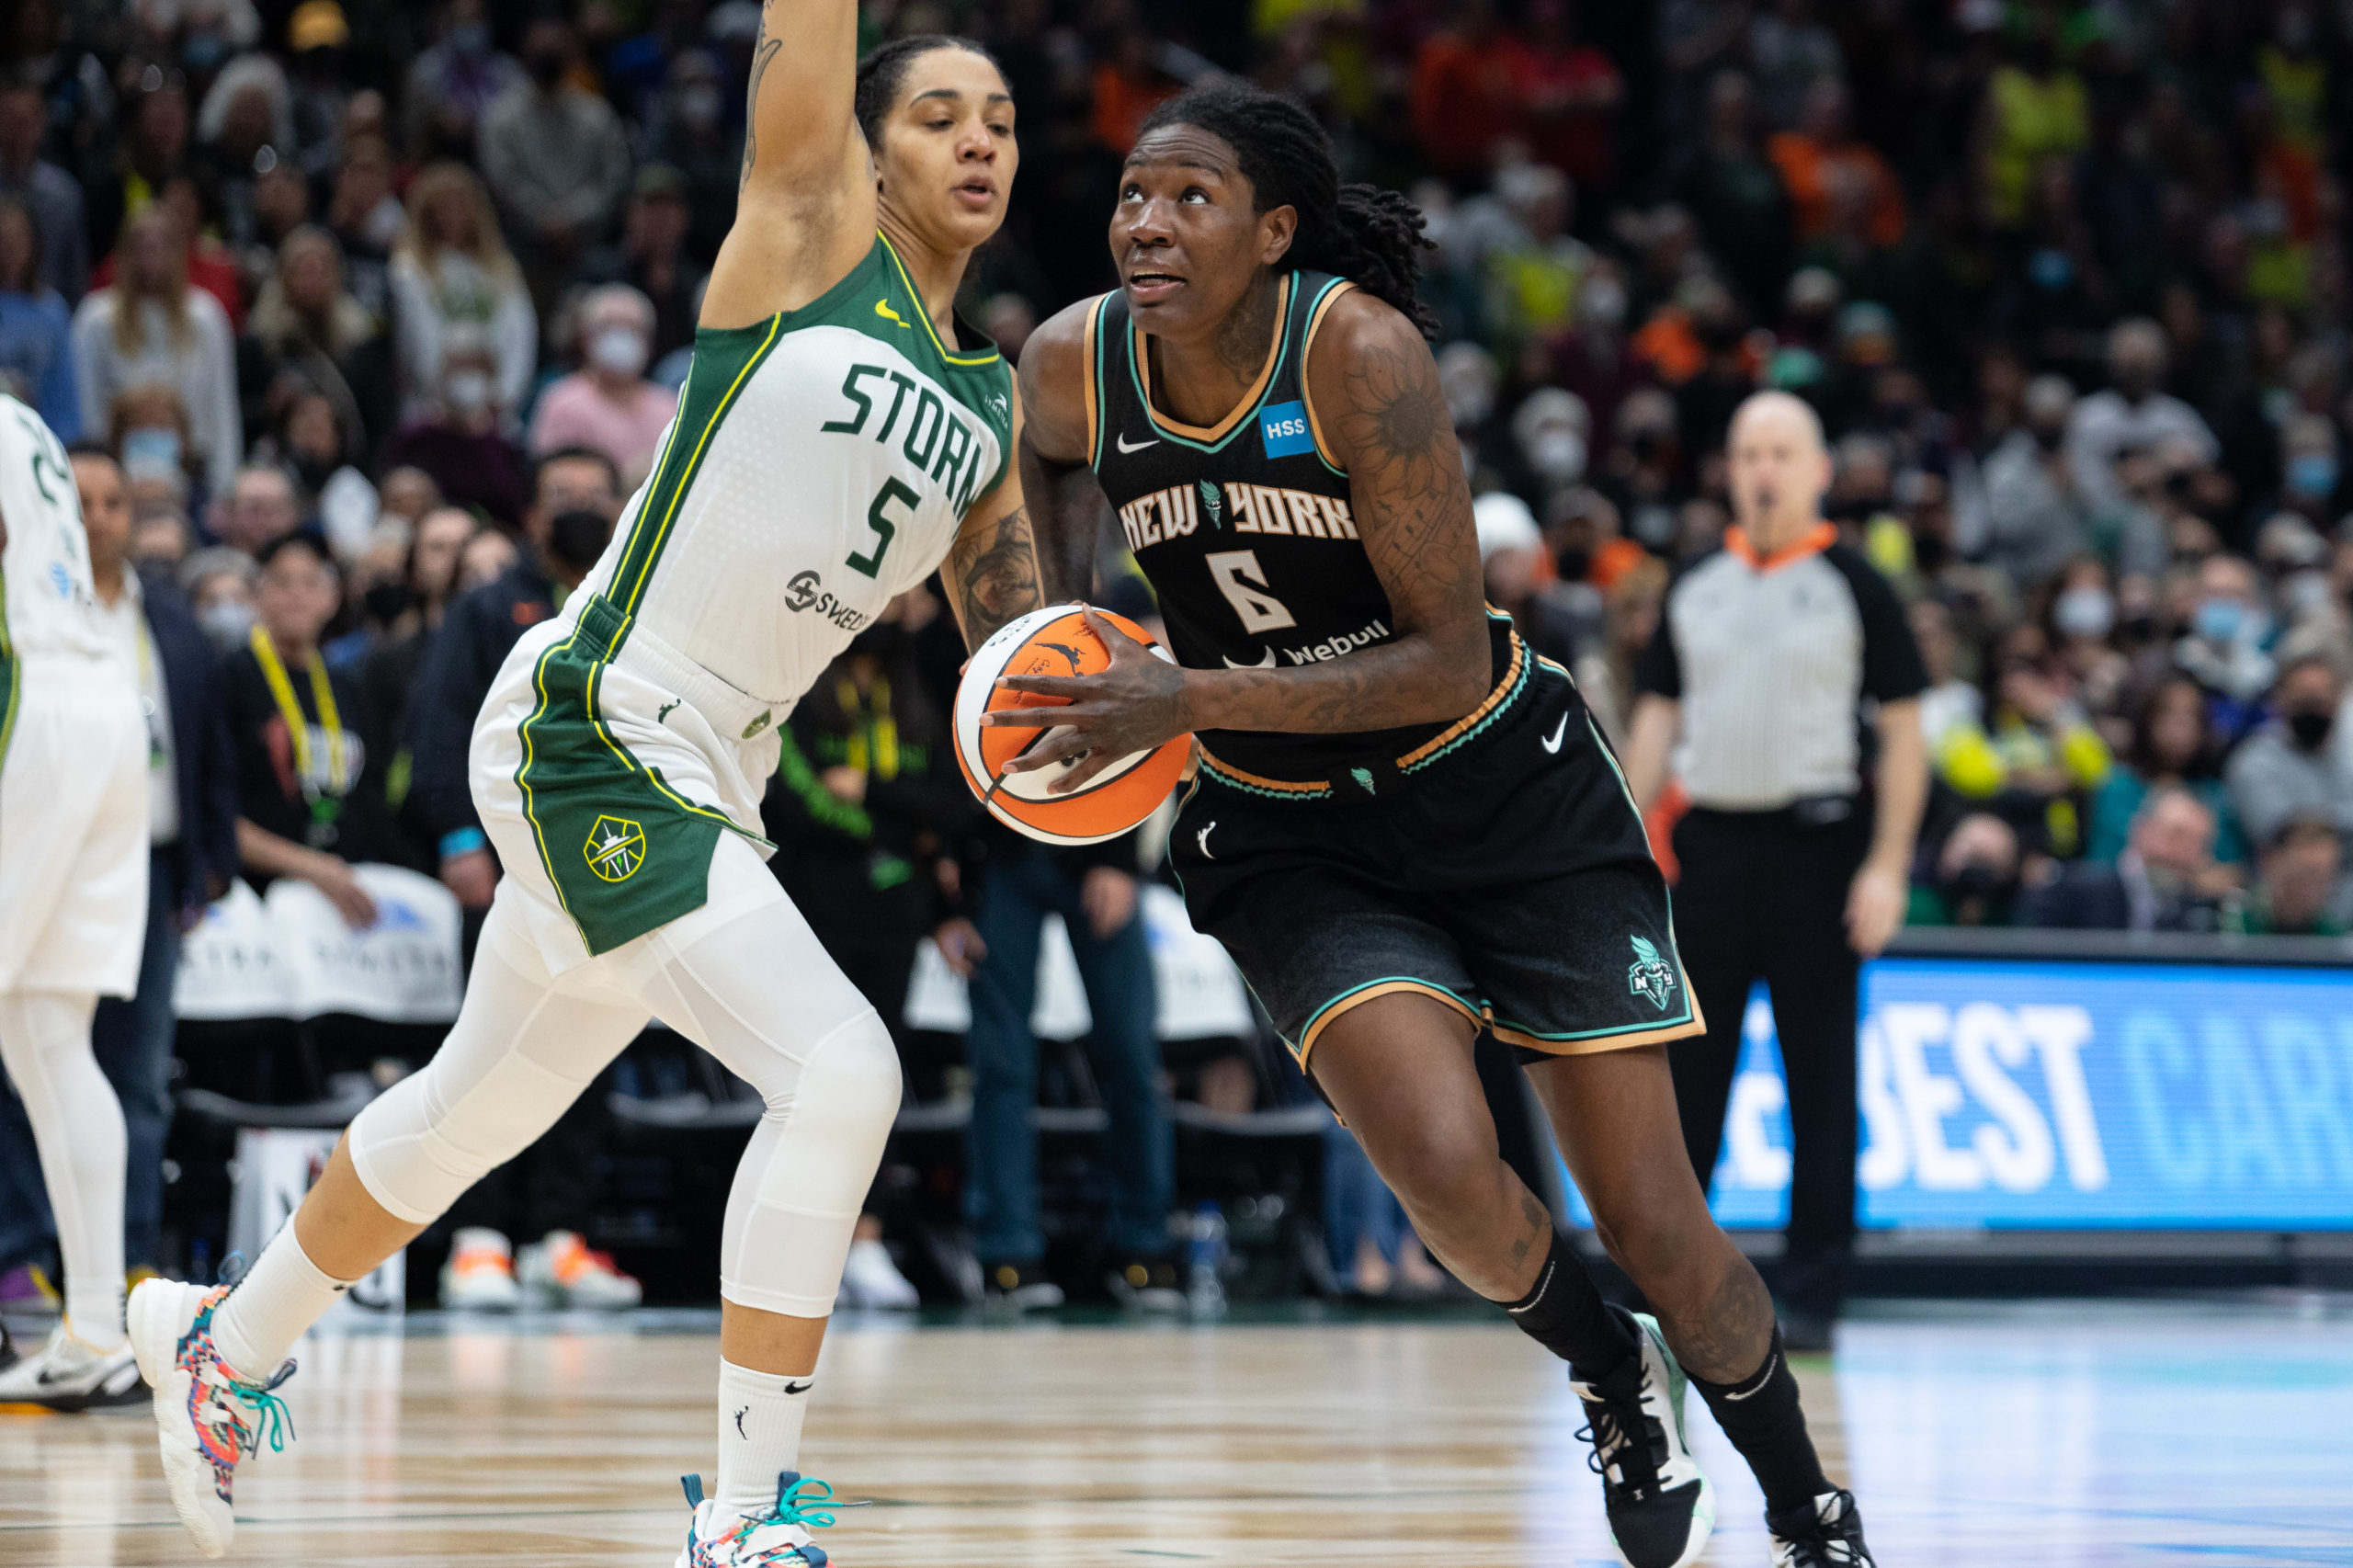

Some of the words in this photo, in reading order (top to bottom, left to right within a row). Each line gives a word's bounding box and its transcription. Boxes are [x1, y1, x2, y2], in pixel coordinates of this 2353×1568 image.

[1267, 417, 1306, 439] HSS
[845, 475, 922, 580] 5
[1119, 483, 1199, 553] NEW
[1223, 482, 1361, 540] YORK
[815, 592, 871, 631] SWED
[1205, 549, 1298, 635] 6
[2120, 1011, 2353, 1188] CAR
